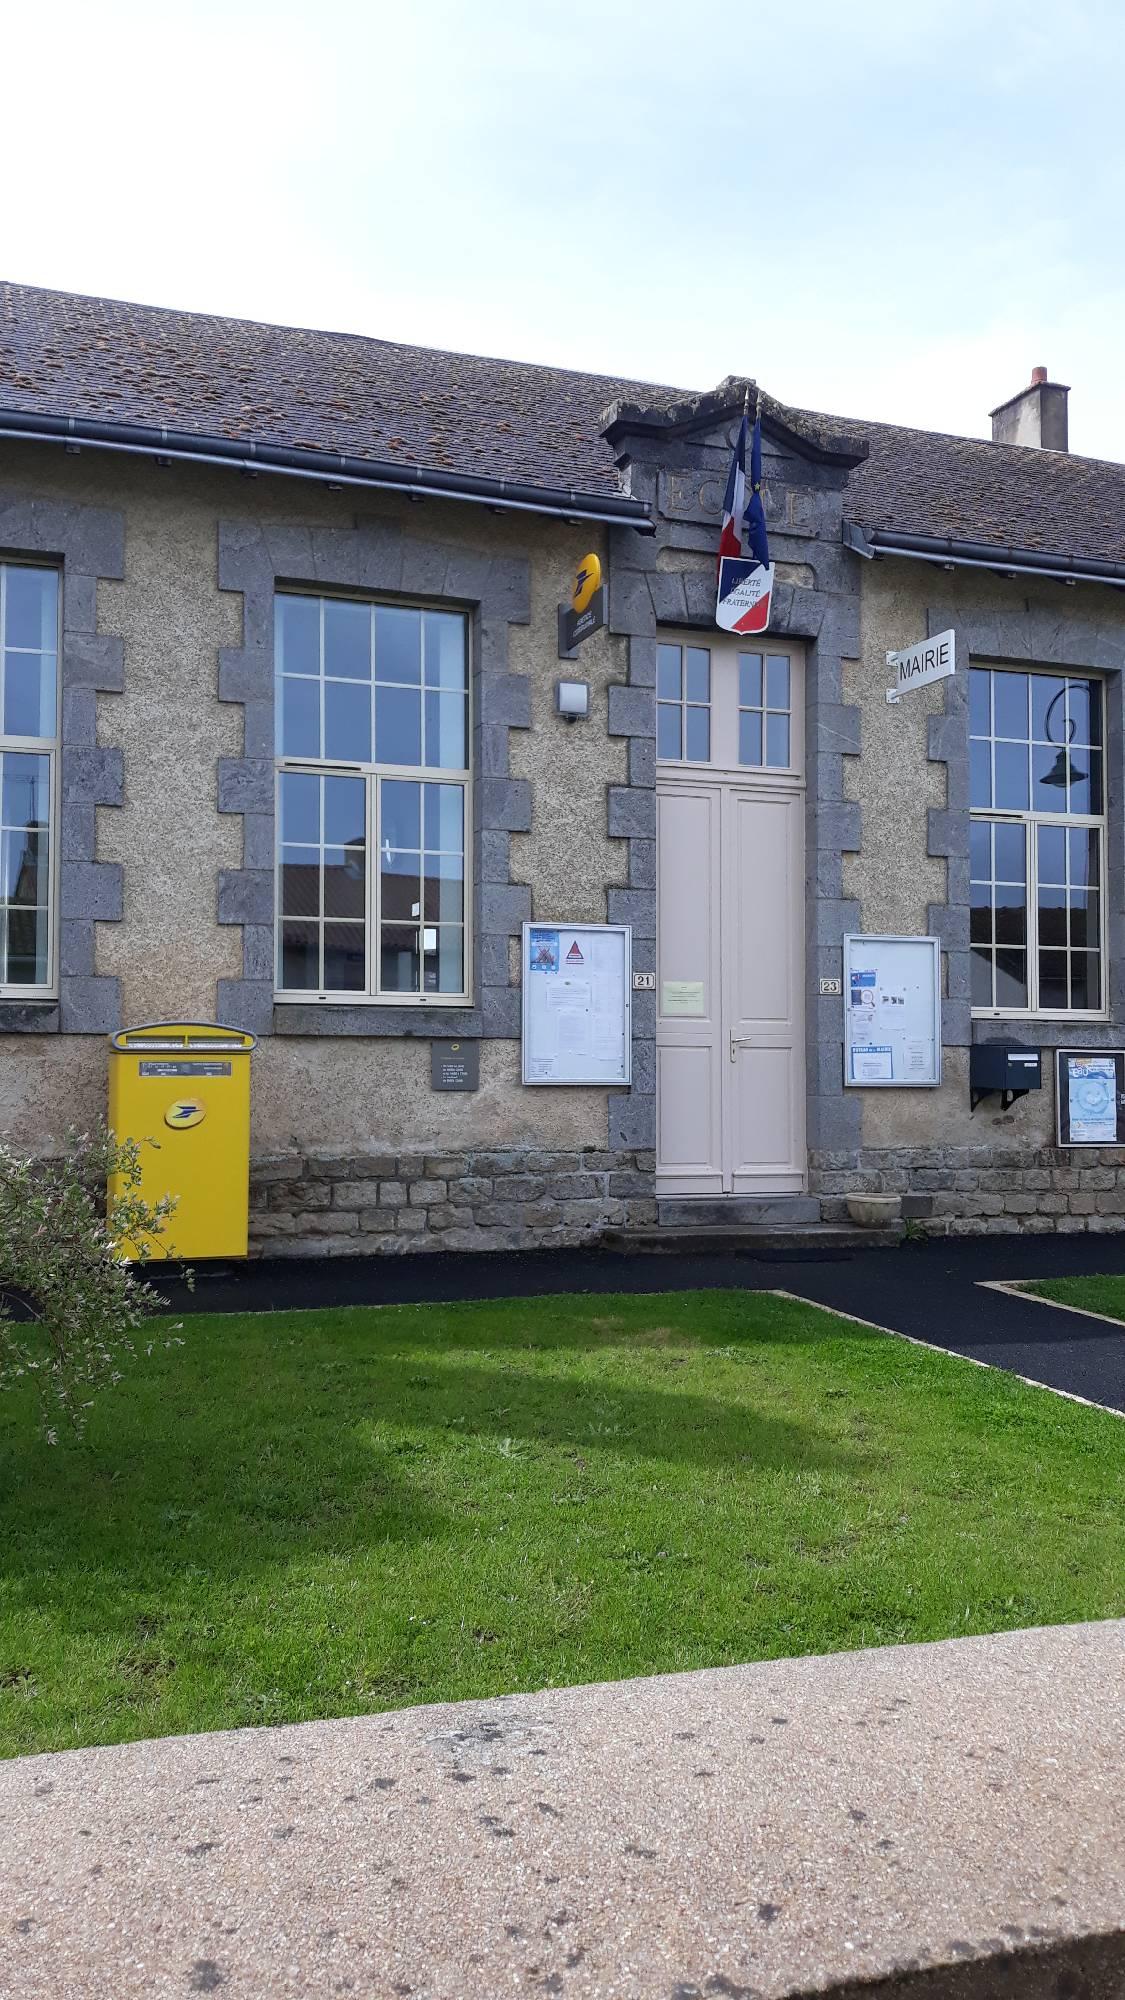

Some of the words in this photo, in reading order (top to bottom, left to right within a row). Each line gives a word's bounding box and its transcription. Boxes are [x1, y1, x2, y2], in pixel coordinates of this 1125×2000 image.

[669, 473, 810, 529] ECE
[900, 642, 949, 681] MAIRIE
[637, 976, 650, 986] 21
[823, 981, 837, 991] 23
